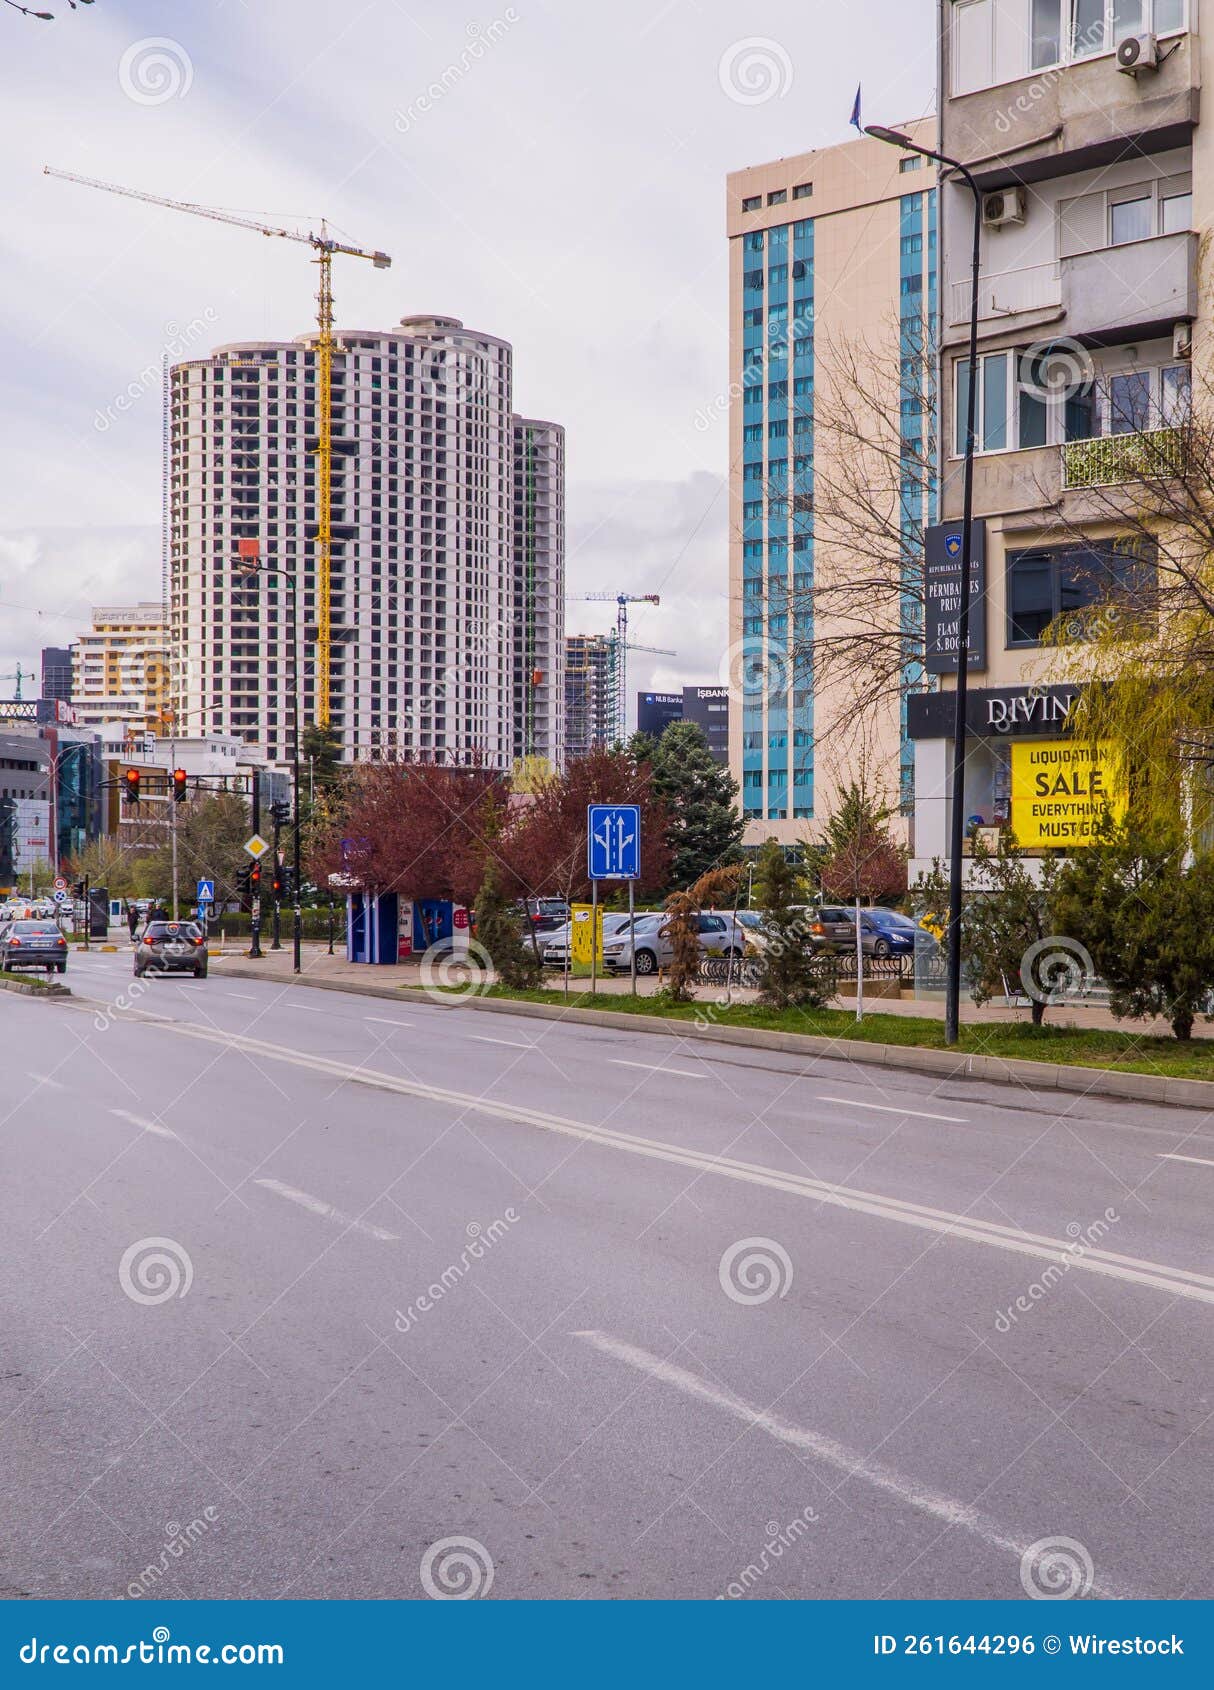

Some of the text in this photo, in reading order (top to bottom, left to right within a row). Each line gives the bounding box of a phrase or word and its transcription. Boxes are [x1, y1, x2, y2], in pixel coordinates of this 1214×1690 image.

[929, 580, 979, 598] PËRMBAES
[655, 695, 667, 703] NLB
[1030, 750, 1107, 765] LIQUIDATION
[1035, 771, 1104, 797] SALE
[1032, 802, 1105, 817] EVERYTHING
[1039, 822, 1076, 837] MUST
